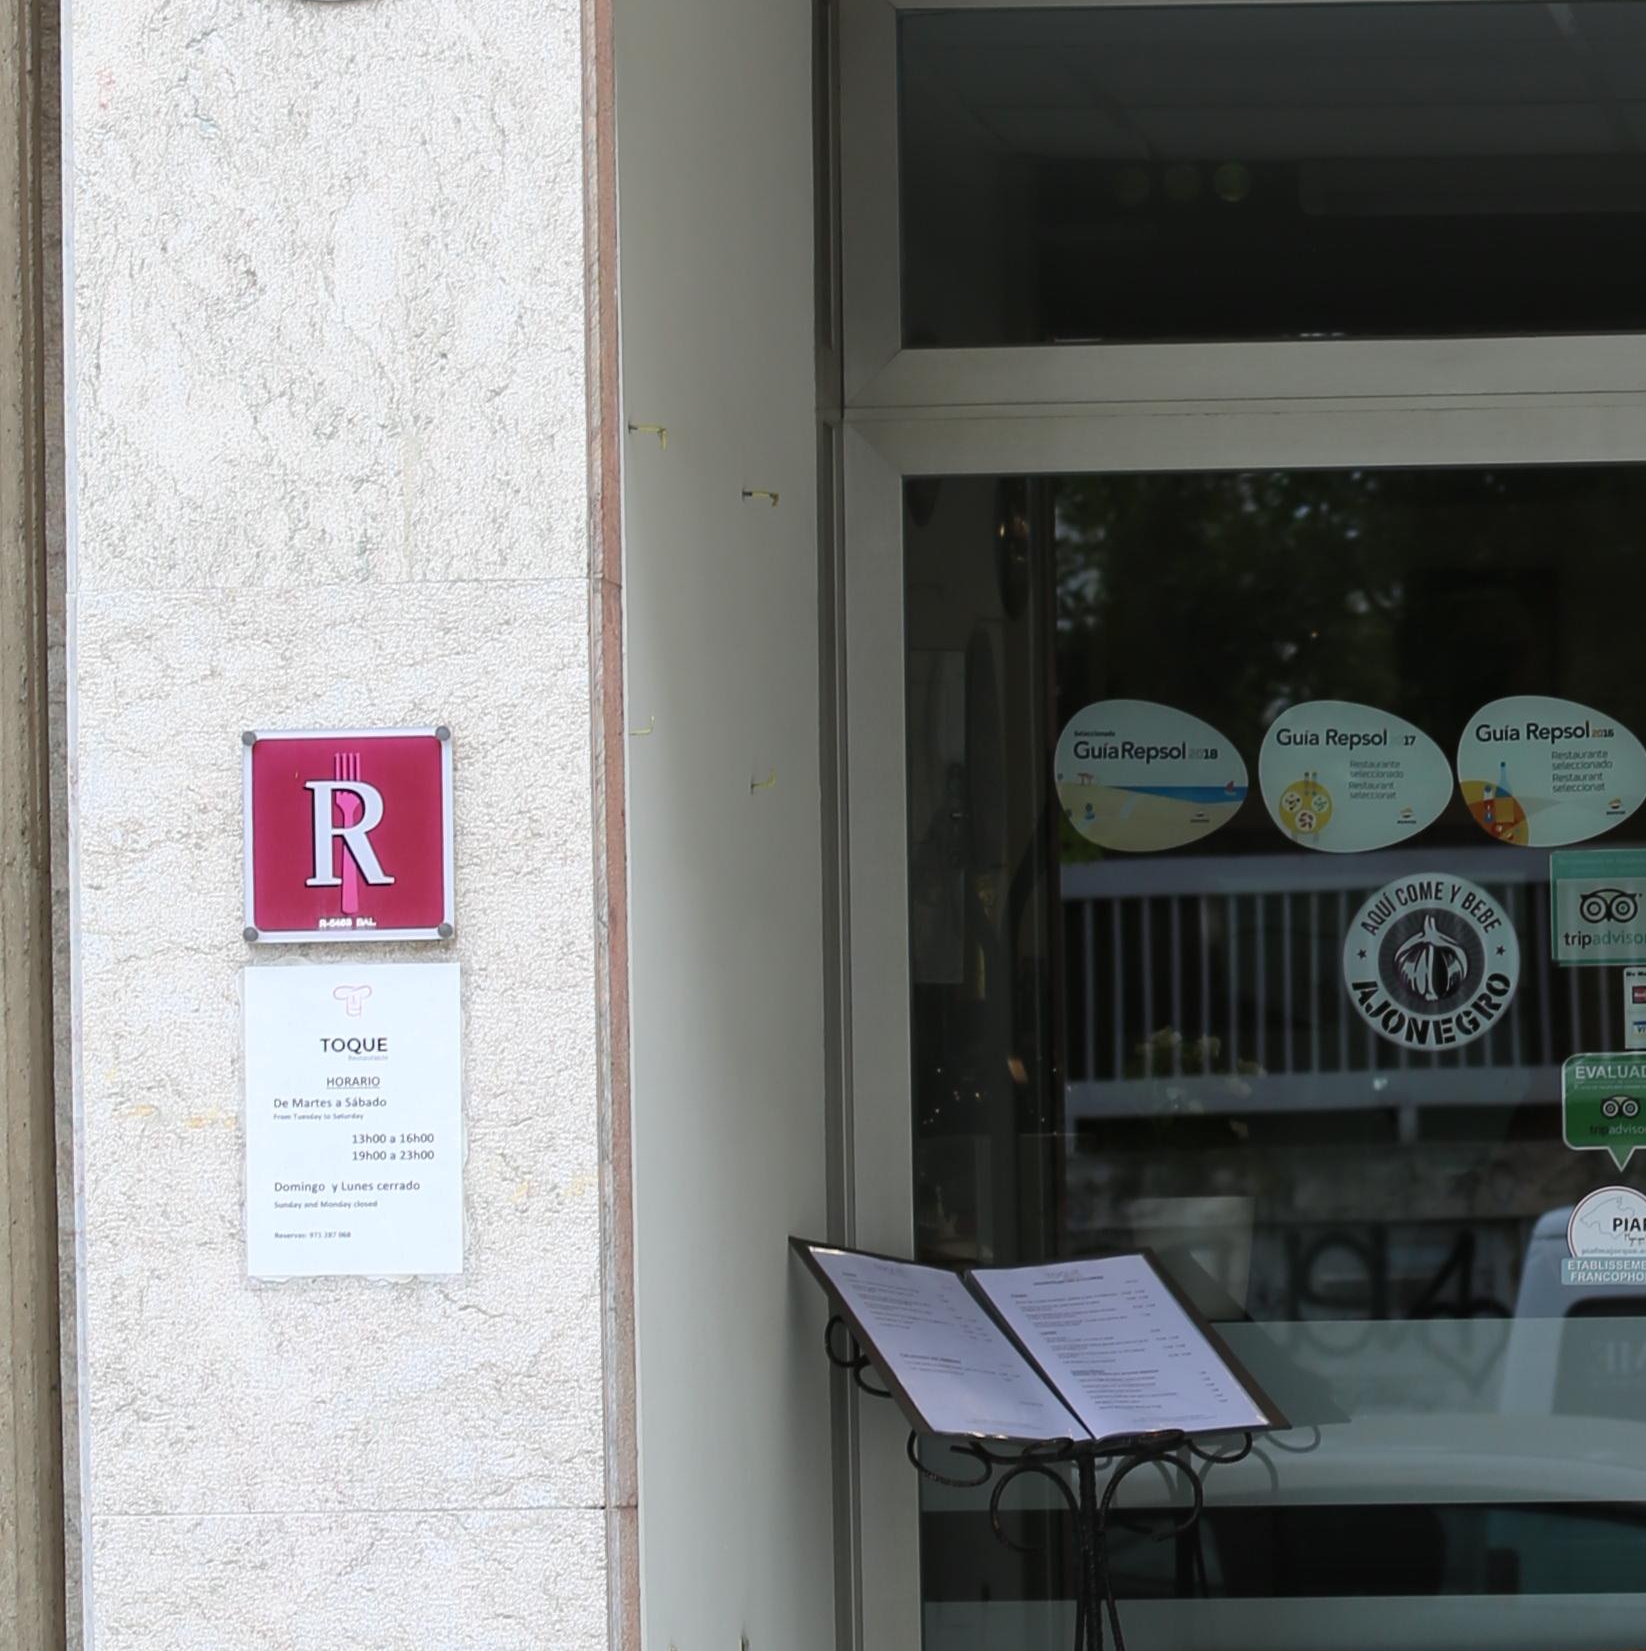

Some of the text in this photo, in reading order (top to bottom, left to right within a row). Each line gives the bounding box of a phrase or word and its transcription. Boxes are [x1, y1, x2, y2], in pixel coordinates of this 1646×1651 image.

[1475, 724, 1520, 742] Guía
[1526, 720, 1590, 744] Repsol
[1276, 728, 1319, 746] Guía
[1326, 728, 1387, 750] Repsol
[1073, 741, 1119, 760] Guía
[1121, 741, 1186, 764] Repsol
[1551, 750, 1608, 760] Restaurante
[1350, 760, 1400, 768] Restaurante
[1552, 760, 1613, 770] seleccionado
[1350, 770, 1404, 779] seleccionado
[1552, 773, 1603, 782] Restaurant
[1349, 781, 1394, 789] Restaurant
[1553, 783, 1605, 793] seleccionat
[1350, 791, 1396, 800] seleccionat
[305, 780, 395, 886] R
[1361, 881, 1502, 936] AQUÍ COME Y BEBE
[1351, 973, 1512, 1045] AJONEGRO
[319, 1037, 389, 1054] TOQUE
[326, 1076, 381, 1087] HORARIO
[273, 1096, 387, 1108] De Martes a Sábado
[352, 1133, 434, 1144] 13h00 a 16h00
[352, 1150, 435, 1161] 19h00 a 23h00
[274, 1180, 421, 1194] Domingo y Lunes cerrado
